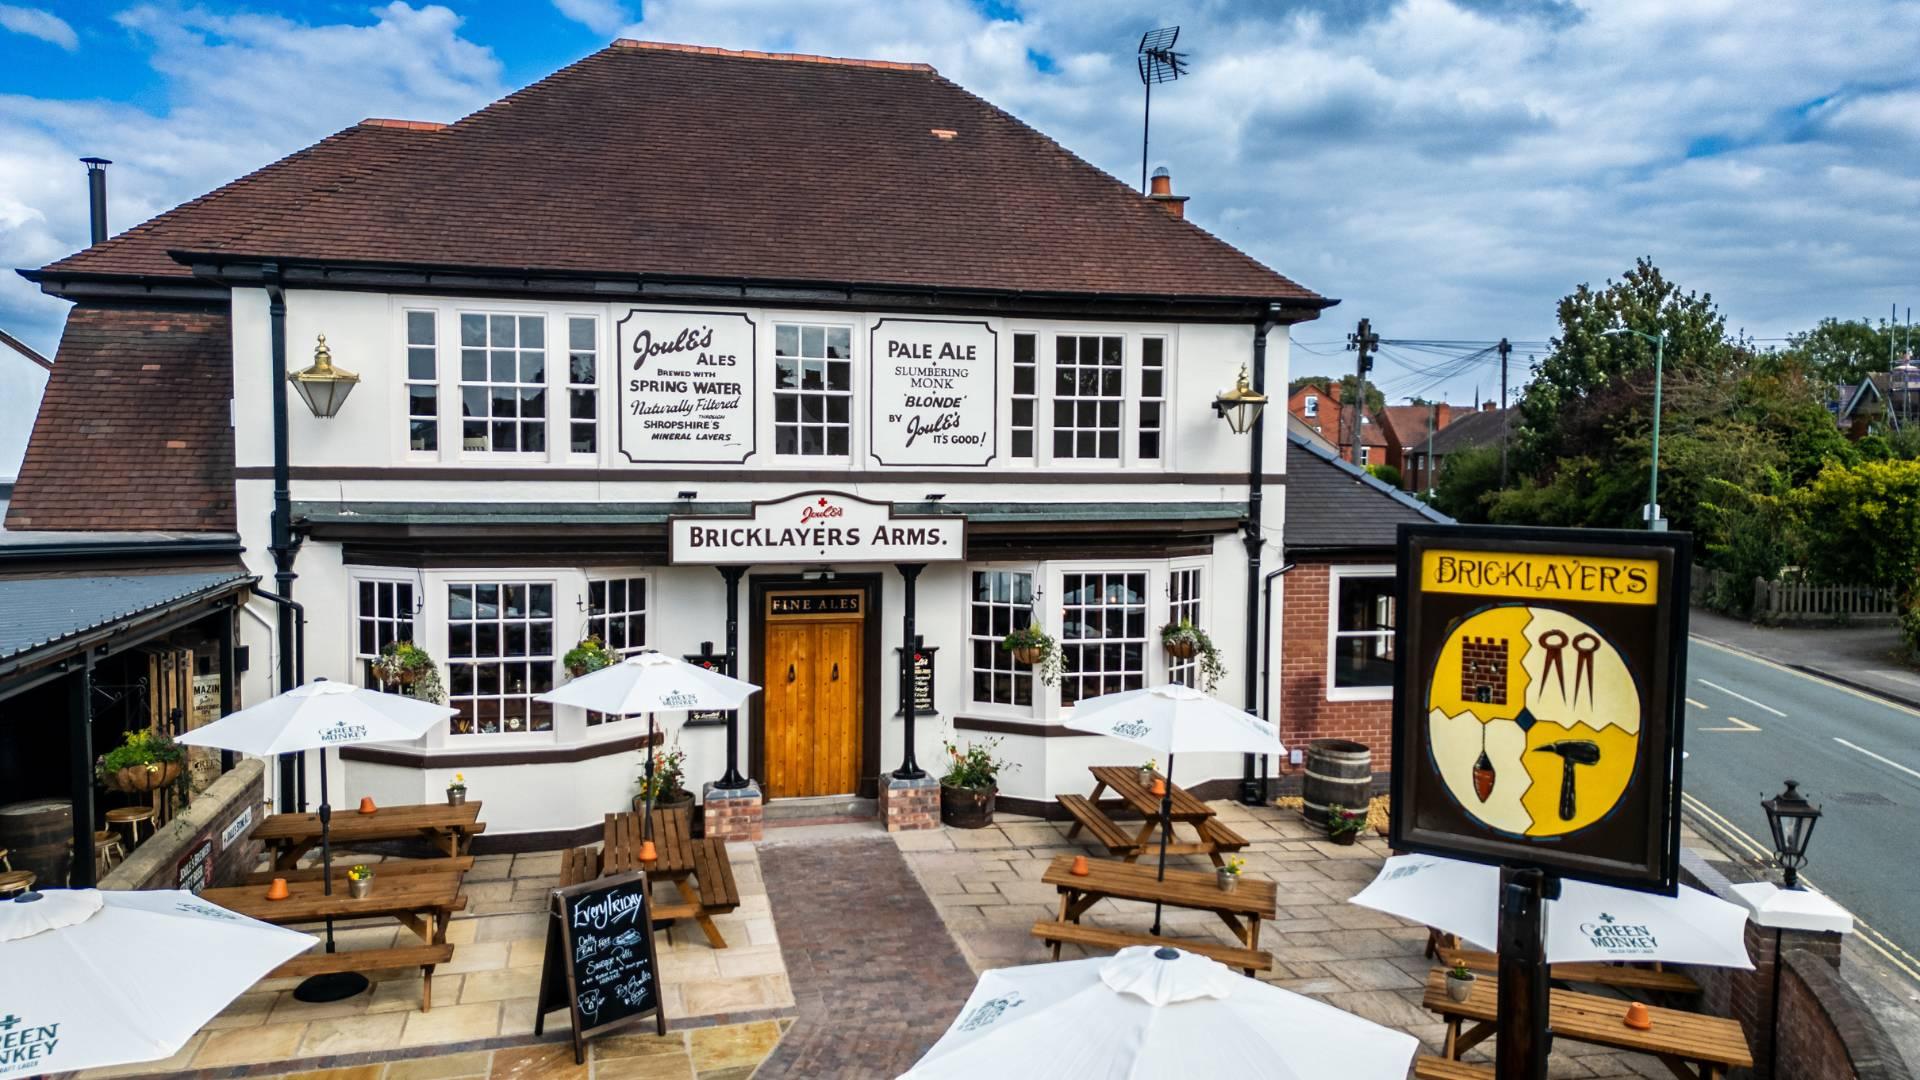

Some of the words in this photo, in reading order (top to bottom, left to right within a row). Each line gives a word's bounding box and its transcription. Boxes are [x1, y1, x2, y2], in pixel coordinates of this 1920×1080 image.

[888, 340, 932, 359] PALE
[938, 342, 976, 361] ALE
[696, 352, 736, 366] ALES
[657, 368, 691, 377] BREWED
[895, 366, 969, 378] SLUMBERING
[630, 380, 688, 393] SPRING
[693, 382, 742, 395] WATER
[911, 378, 954, 389] MONK
[630, 400, 694, 417] Naturally
[695, 396, 741, 412] Filtered
[889, 414, 903, 423] BY
[643, 420, 720, 430] SHROPSHIRE'S
[651, 433, 692, 441] MINERAL
[696, 433, 732, 441] LAYERS
[933, 434, 949, 444] IT'S
[690, 526, 860, 547] BRICKLAYERS
[871, 525, 948, 546] ARMS.
[1434, 555, 1649, 594] BRICKLAYER'S
[773, 599, 812, 610] FINE
[819, 598, 858, 609] ALES
[193, 684, 220, 695] MAZIN
[574, 895, 608, 929] Every
[1580, 922, 1650, 936] GREEN
[1590, 936, 1658, 948] MONKEY
[0, 1023, 61, 1048] EEN
